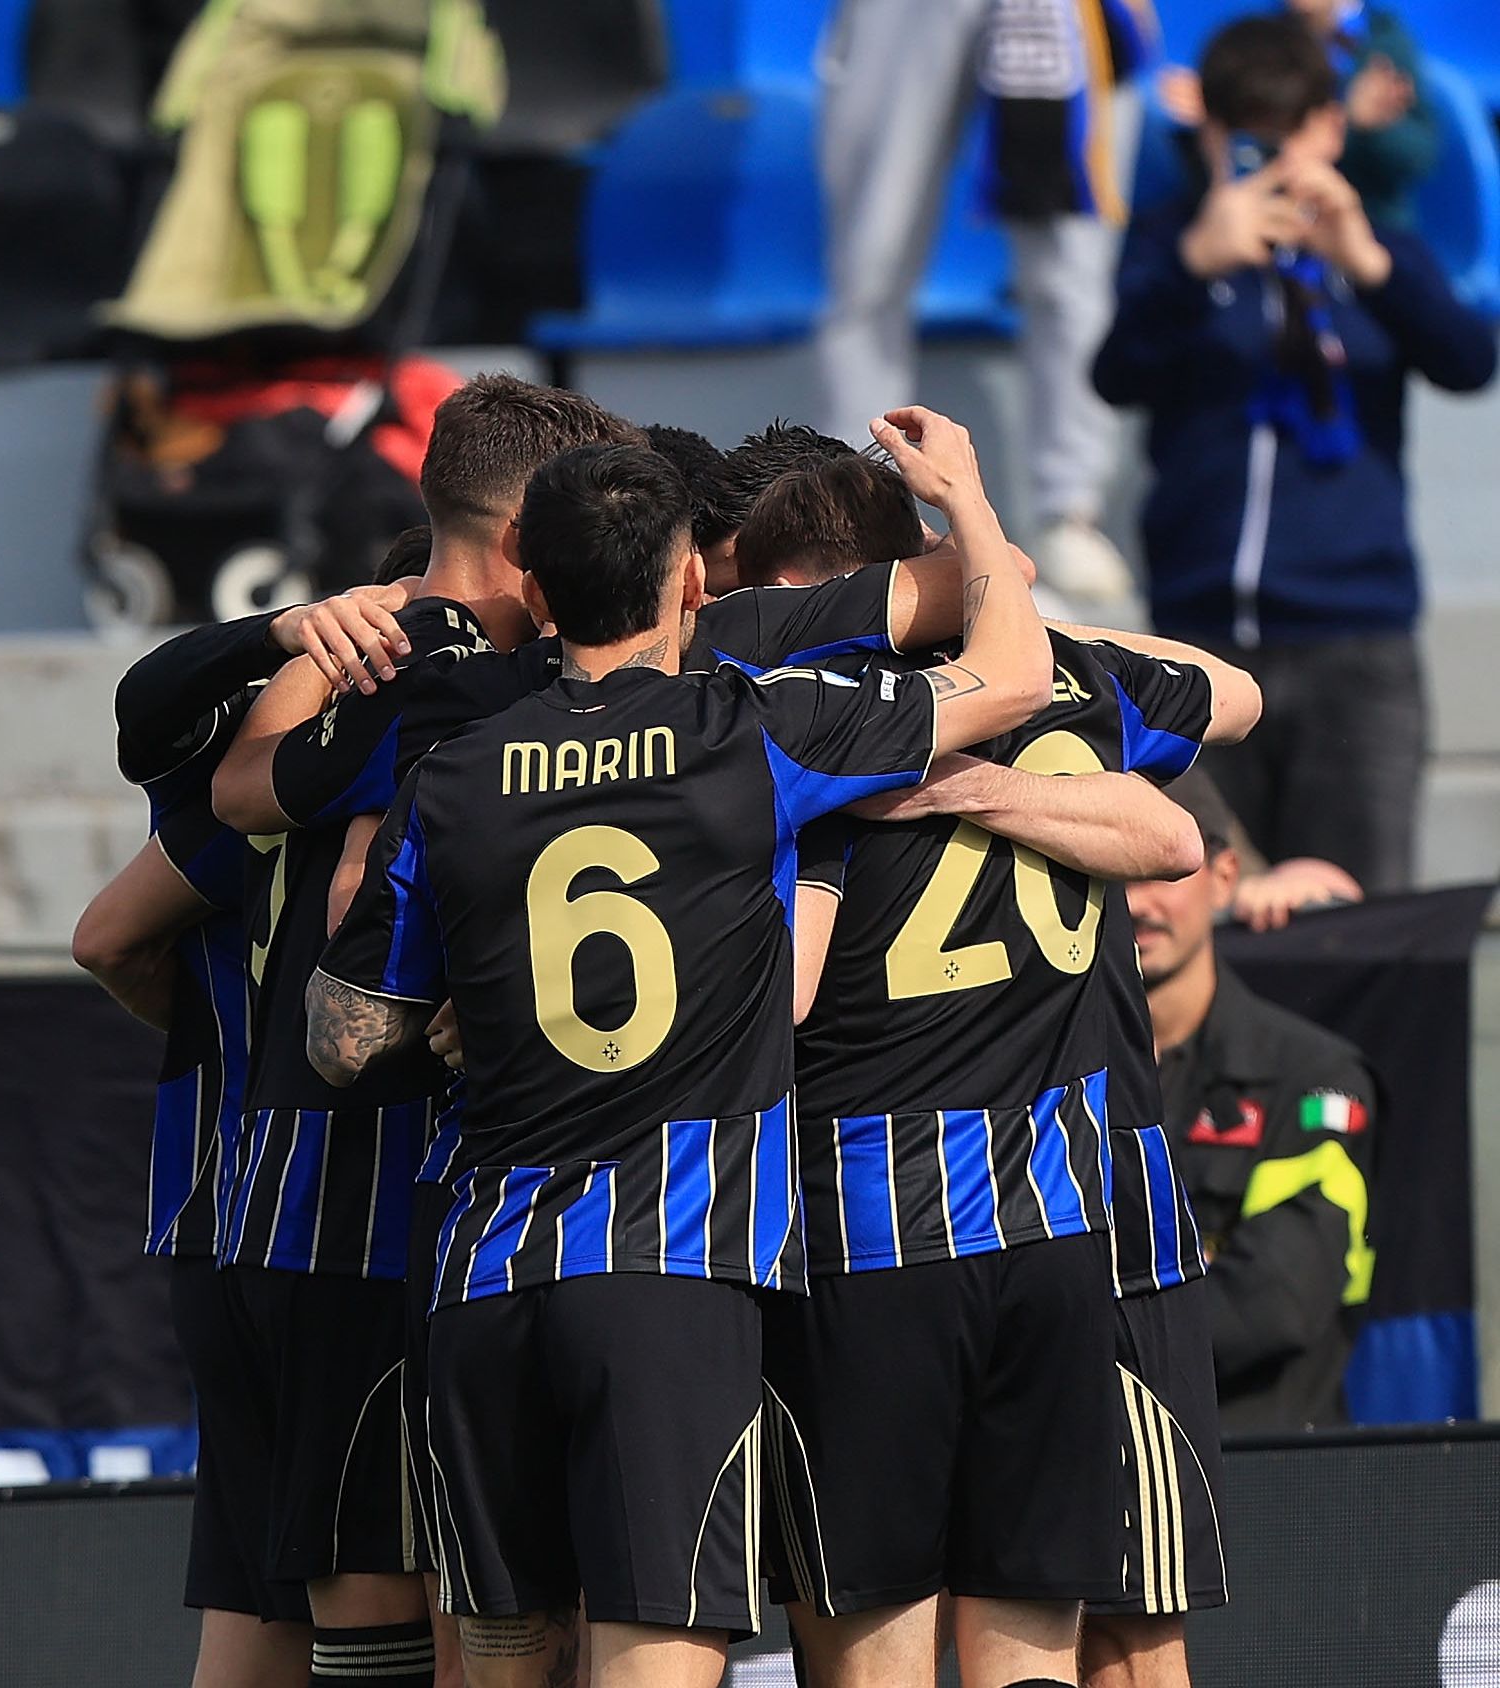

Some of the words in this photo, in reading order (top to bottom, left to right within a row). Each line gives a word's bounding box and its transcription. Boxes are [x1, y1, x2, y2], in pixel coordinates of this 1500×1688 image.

[502, 726, 676, 795] MARIN
[886, 730, 1107, 1001] 20
[526, 824, 678, 1073] 6
